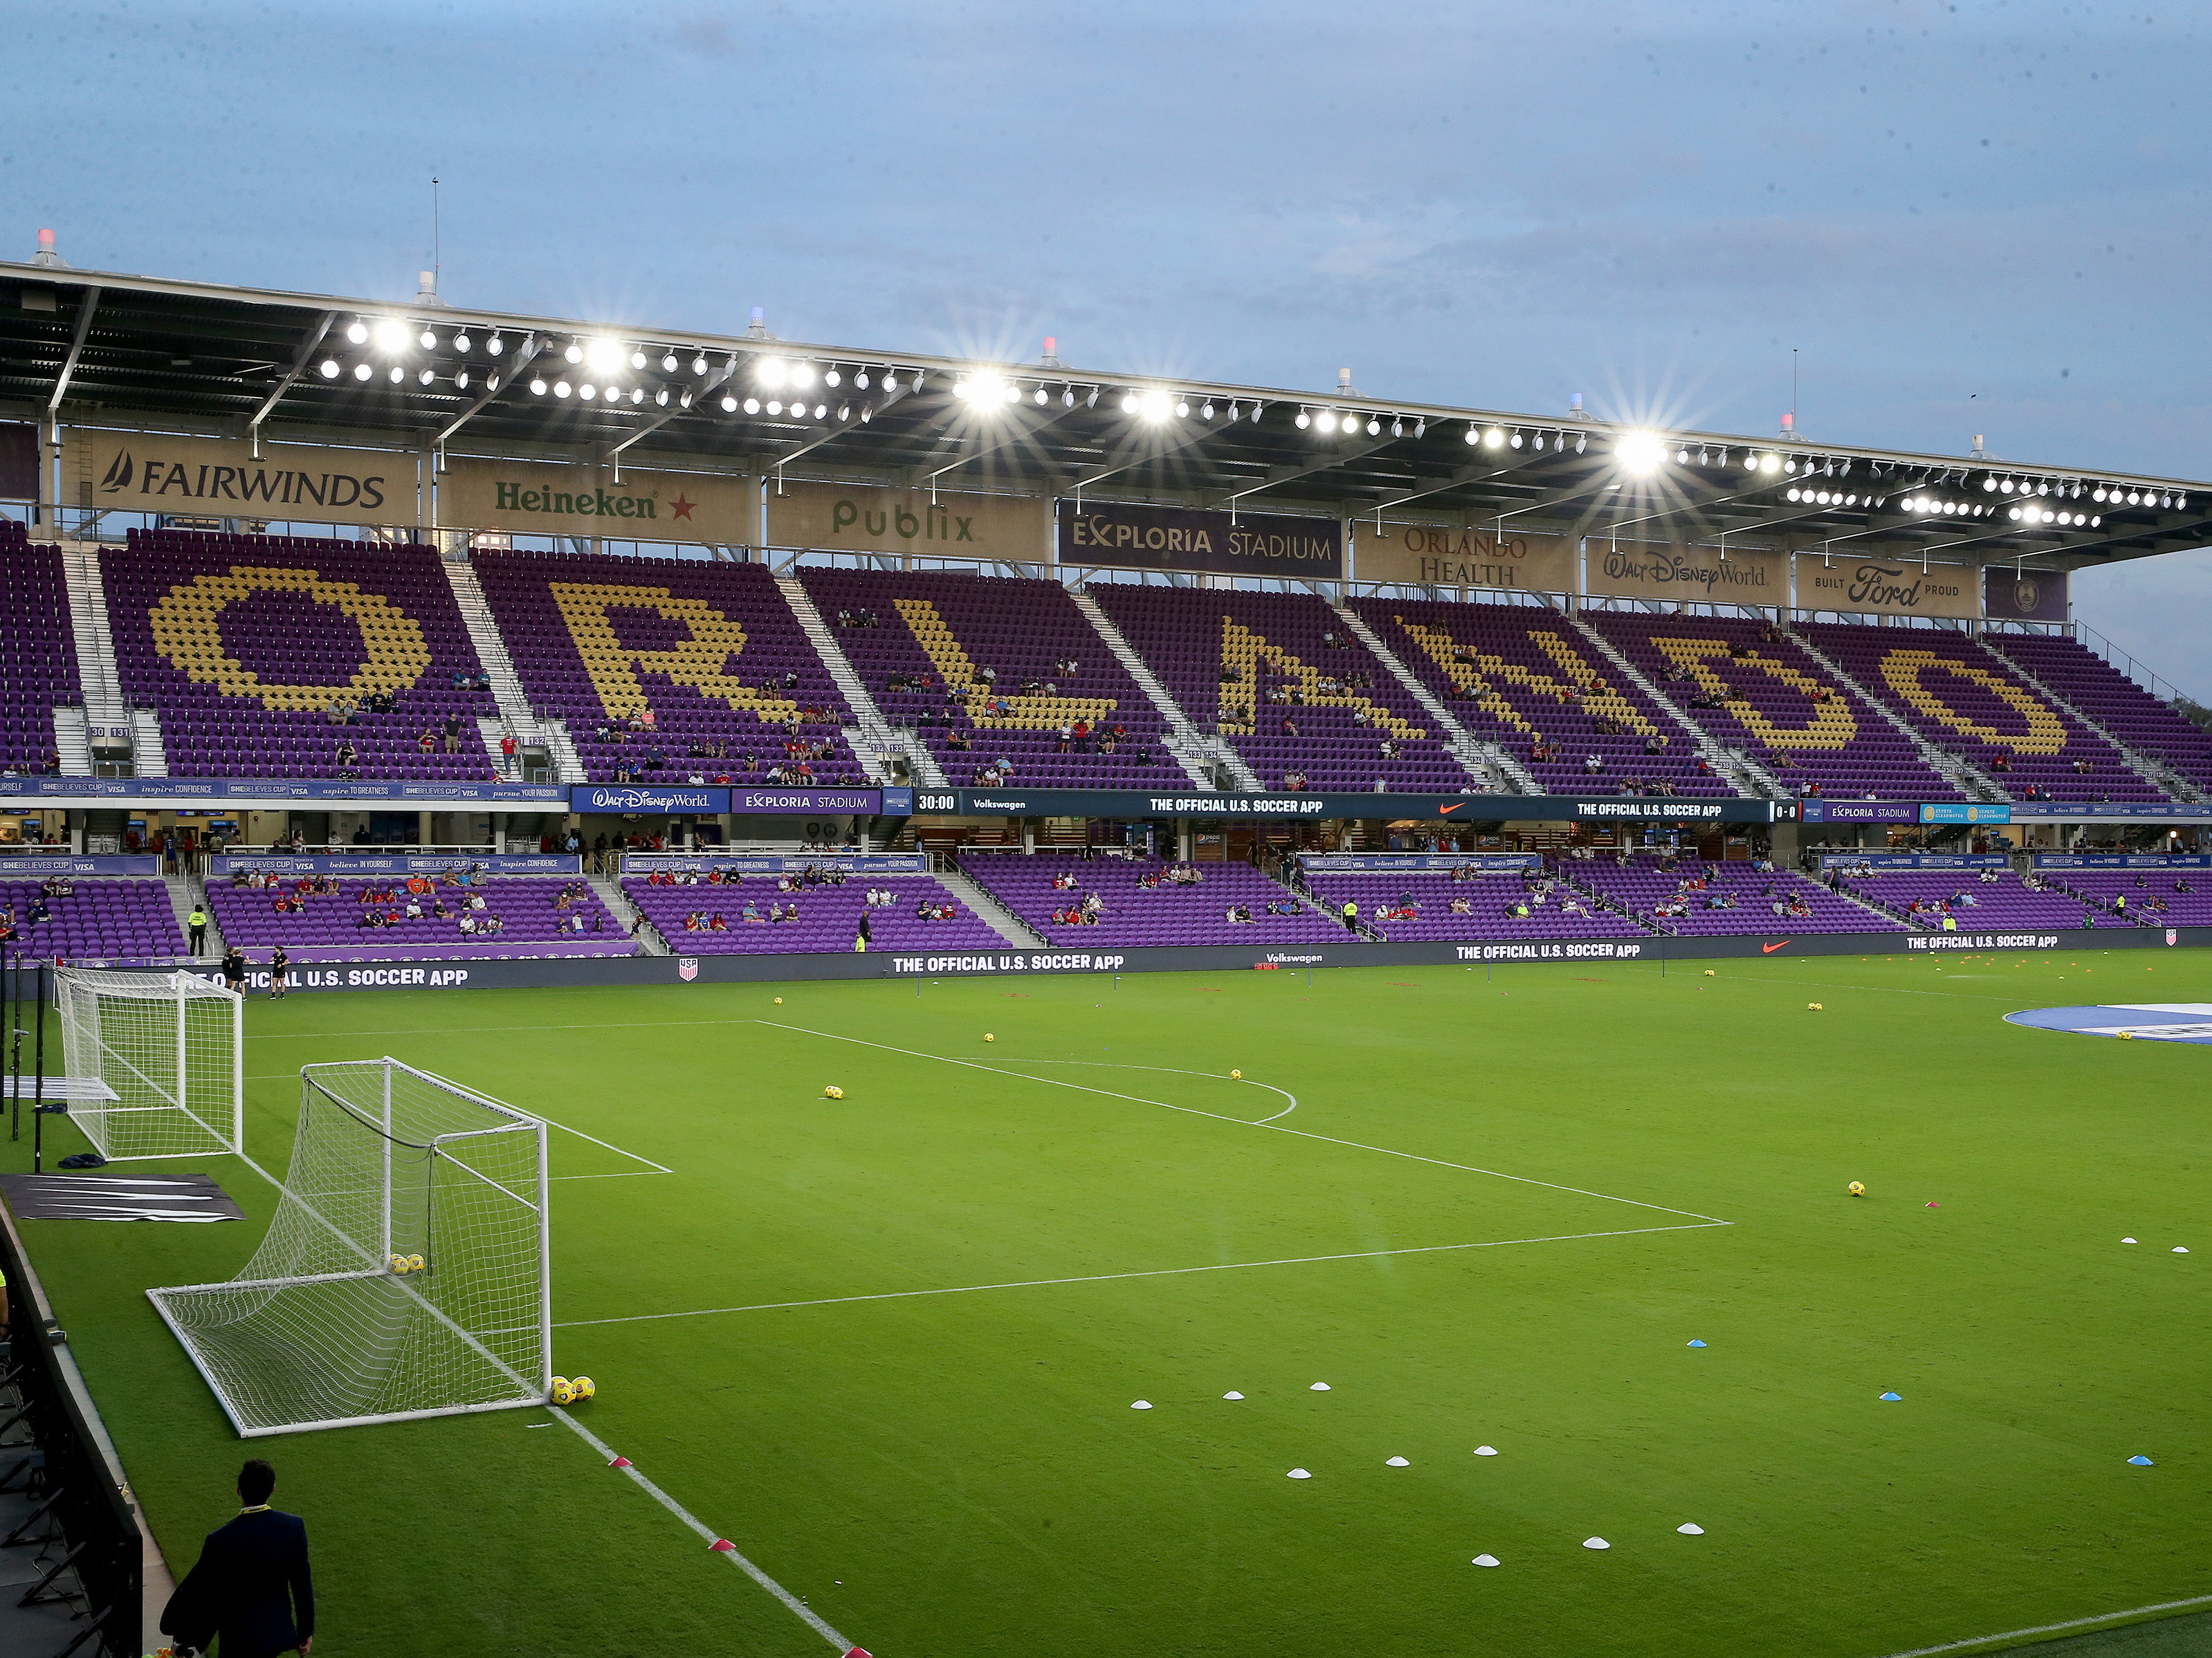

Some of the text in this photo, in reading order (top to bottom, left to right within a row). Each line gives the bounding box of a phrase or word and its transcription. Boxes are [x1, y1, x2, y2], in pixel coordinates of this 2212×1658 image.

[139, 461, 385, 509] FAIRWINDS
[495, 481, 657, 519] Heineken
[833, 499, 974, 542] Publix
[1073, 515, 1331, 561] EXPLORIA STADIUM
[1404, 528, 1527, 559] ORLANDO
[1419, 557, 1515, 586] HEALTH
[1718, 564, 1765, 587] World
[1815, 564, 1959, 607] BUILT Ford PROUD
[112, 728, 129, 737] 131
[529, 737, 545, 745] 132
[141, 784, 212, 794] inspire CONFIDENCE
[358, 786, 389, 795] GREATNESS
[673, 794, 707, 807] World
[745, 792, 868, 808] EXPLORIA STADIUM
[919, 795, 955, 810] 30:00
[973, 798, 1026, 810] Volkswagen
[1150, 798, 1323, 813] THE OFFICIAL U.S. SOCCER APP
[1577, 803, 1721, 817] THE OFFICIAL U.S. SOCCER APP
[1832, 805, 1874, 818] EXPLORIA
[1877, 808, 1910, 818] STADIUM
[1907, 934, 2058, 949] THE OFFICIAL U.S. SOCCER APP
[1266, 953, 1323, 964] Volkswagen
[1456, 943, 1640, 959] THE OFFICIAL U.S. SOCCER APP
[680, 959, 697, 968] USA
[893, 955, 1124, 973] THE OFFICIAL U.S. SOCCER APP
[212, 970, 302, 989] OFICIAL
[307, 970, 344, 986] U.S.
[348, 968, 426, 986] SOCCER
[429, 970, 468, 986] APP
